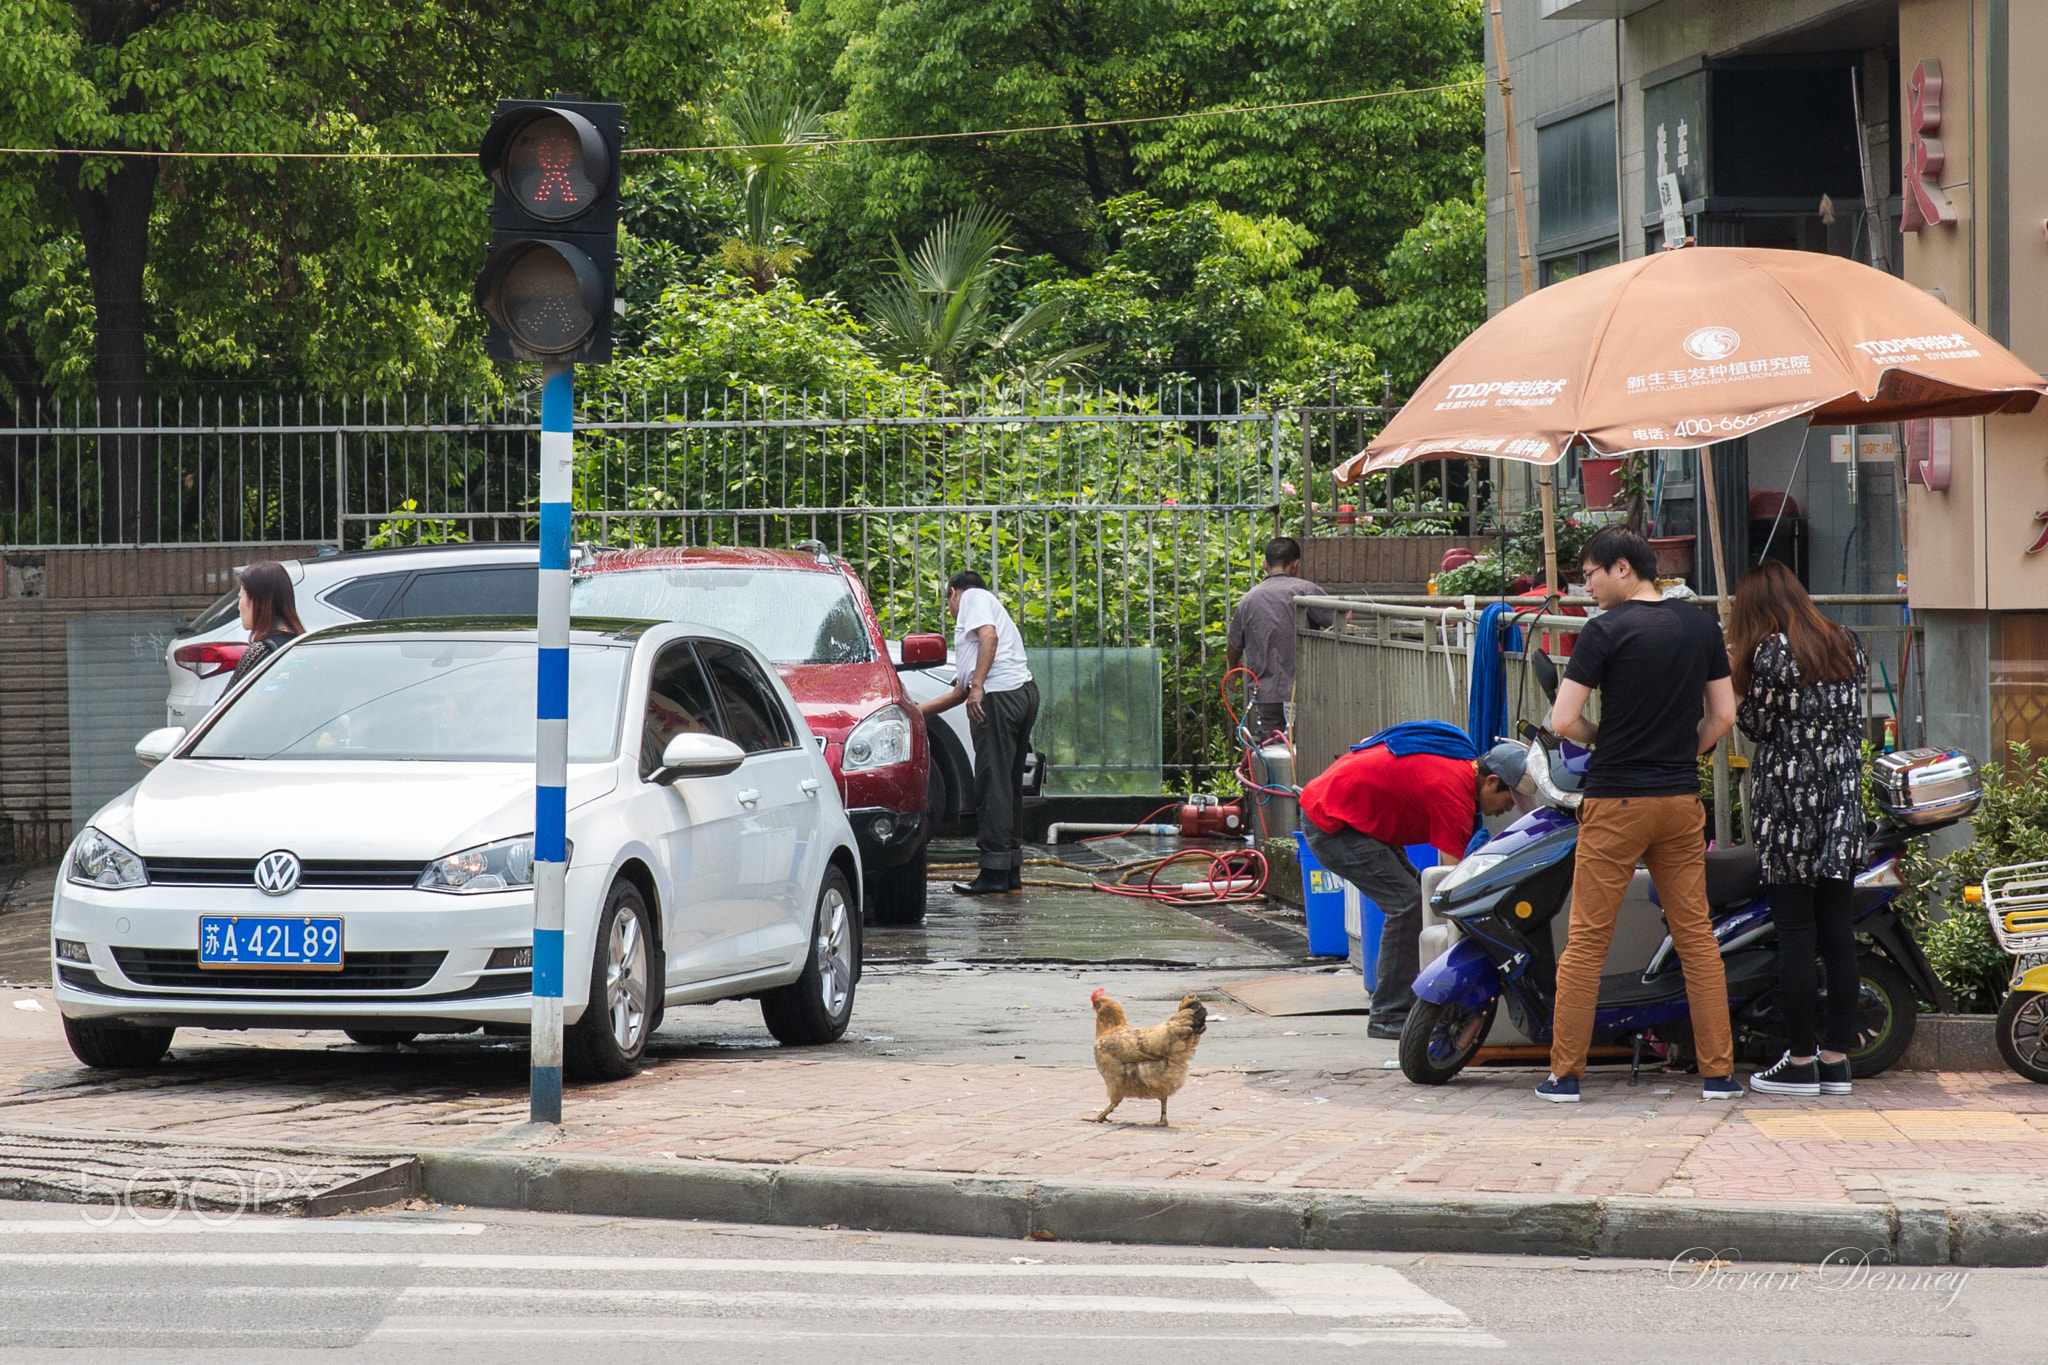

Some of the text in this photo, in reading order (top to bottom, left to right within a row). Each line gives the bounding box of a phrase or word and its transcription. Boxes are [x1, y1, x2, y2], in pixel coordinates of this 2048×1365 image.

[1854, 333, 1971, 356] TDDP专利技术
[1626, 355, 1811, 389] 新生毛发种植研究院
[1628, 367, 1812, 395] HAIR FOLLICLE TRANSPLANTATION INSTITUTE
[1445, 378, 1567, 399] TDDP专利技术
[205, 924, 337, 957] 苏A·42L89
